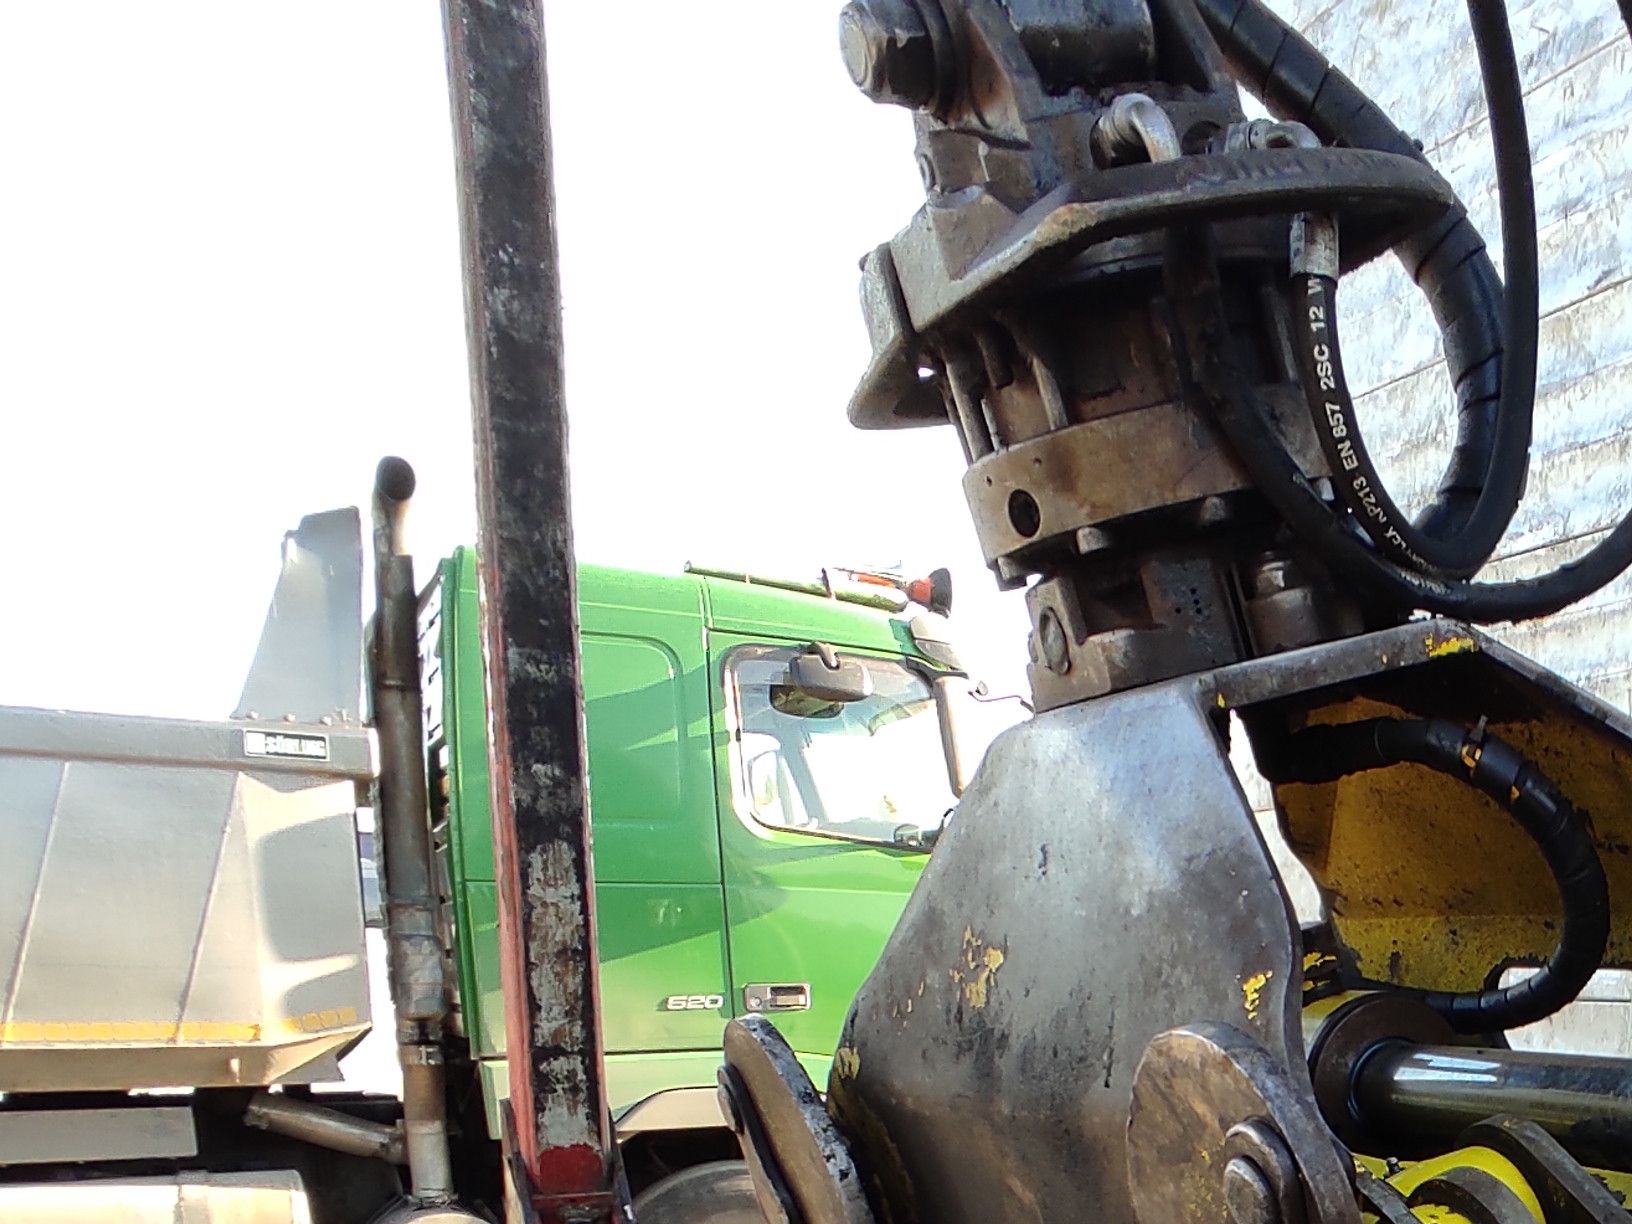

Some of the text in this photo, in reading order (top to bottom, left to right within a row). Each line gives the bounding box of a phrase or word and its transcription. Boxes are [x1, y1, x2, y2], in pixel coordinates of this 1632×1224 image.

[1308, 305, 1326, 333] 12
[1313, 343, 1336, 391] 2SC
[1325, 401, 1347, 438] 857
[1337, 440, 1359, 471] EN
